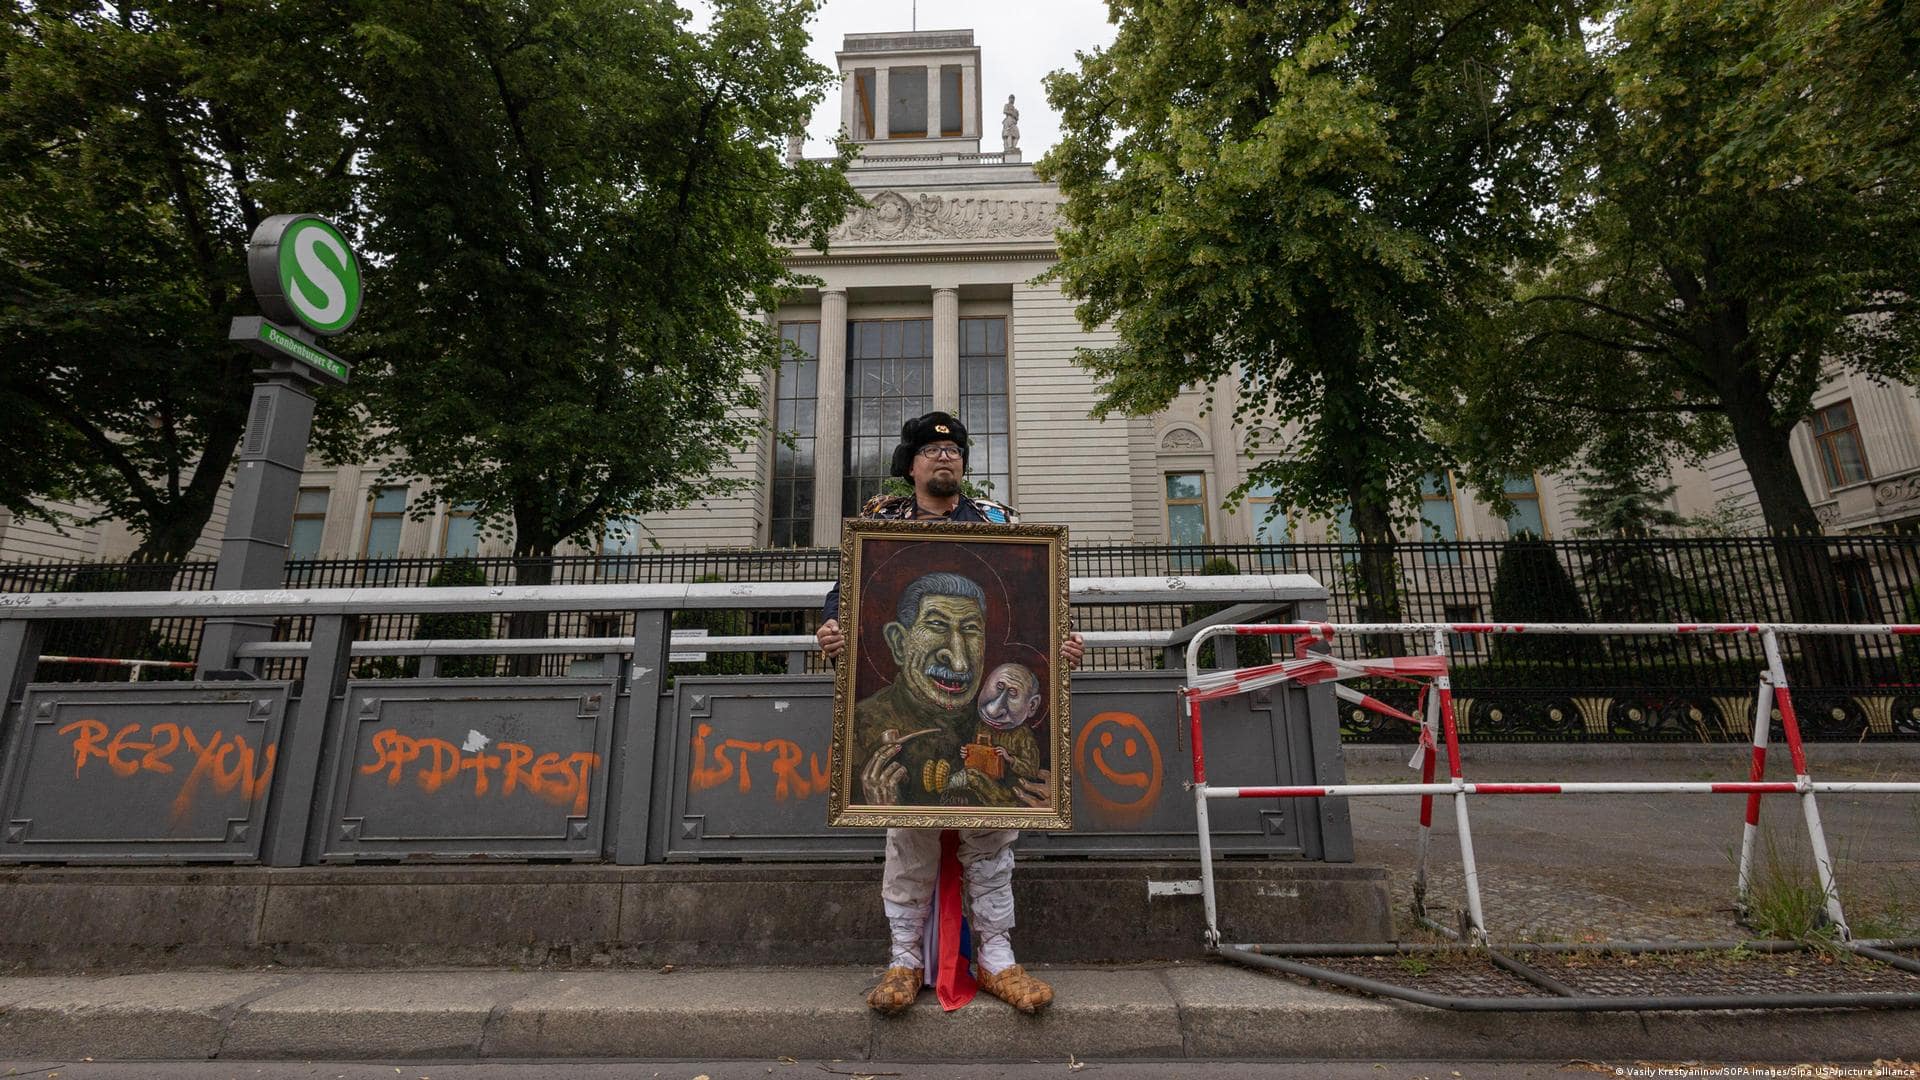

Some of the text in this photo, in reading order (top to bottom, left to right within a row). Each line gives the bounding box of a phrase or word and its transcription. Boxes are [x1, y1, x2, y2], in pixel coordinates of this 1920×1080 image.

[290, 227, 348, 324] S
[269, 329, 342, 374] Brandenburger Tor
